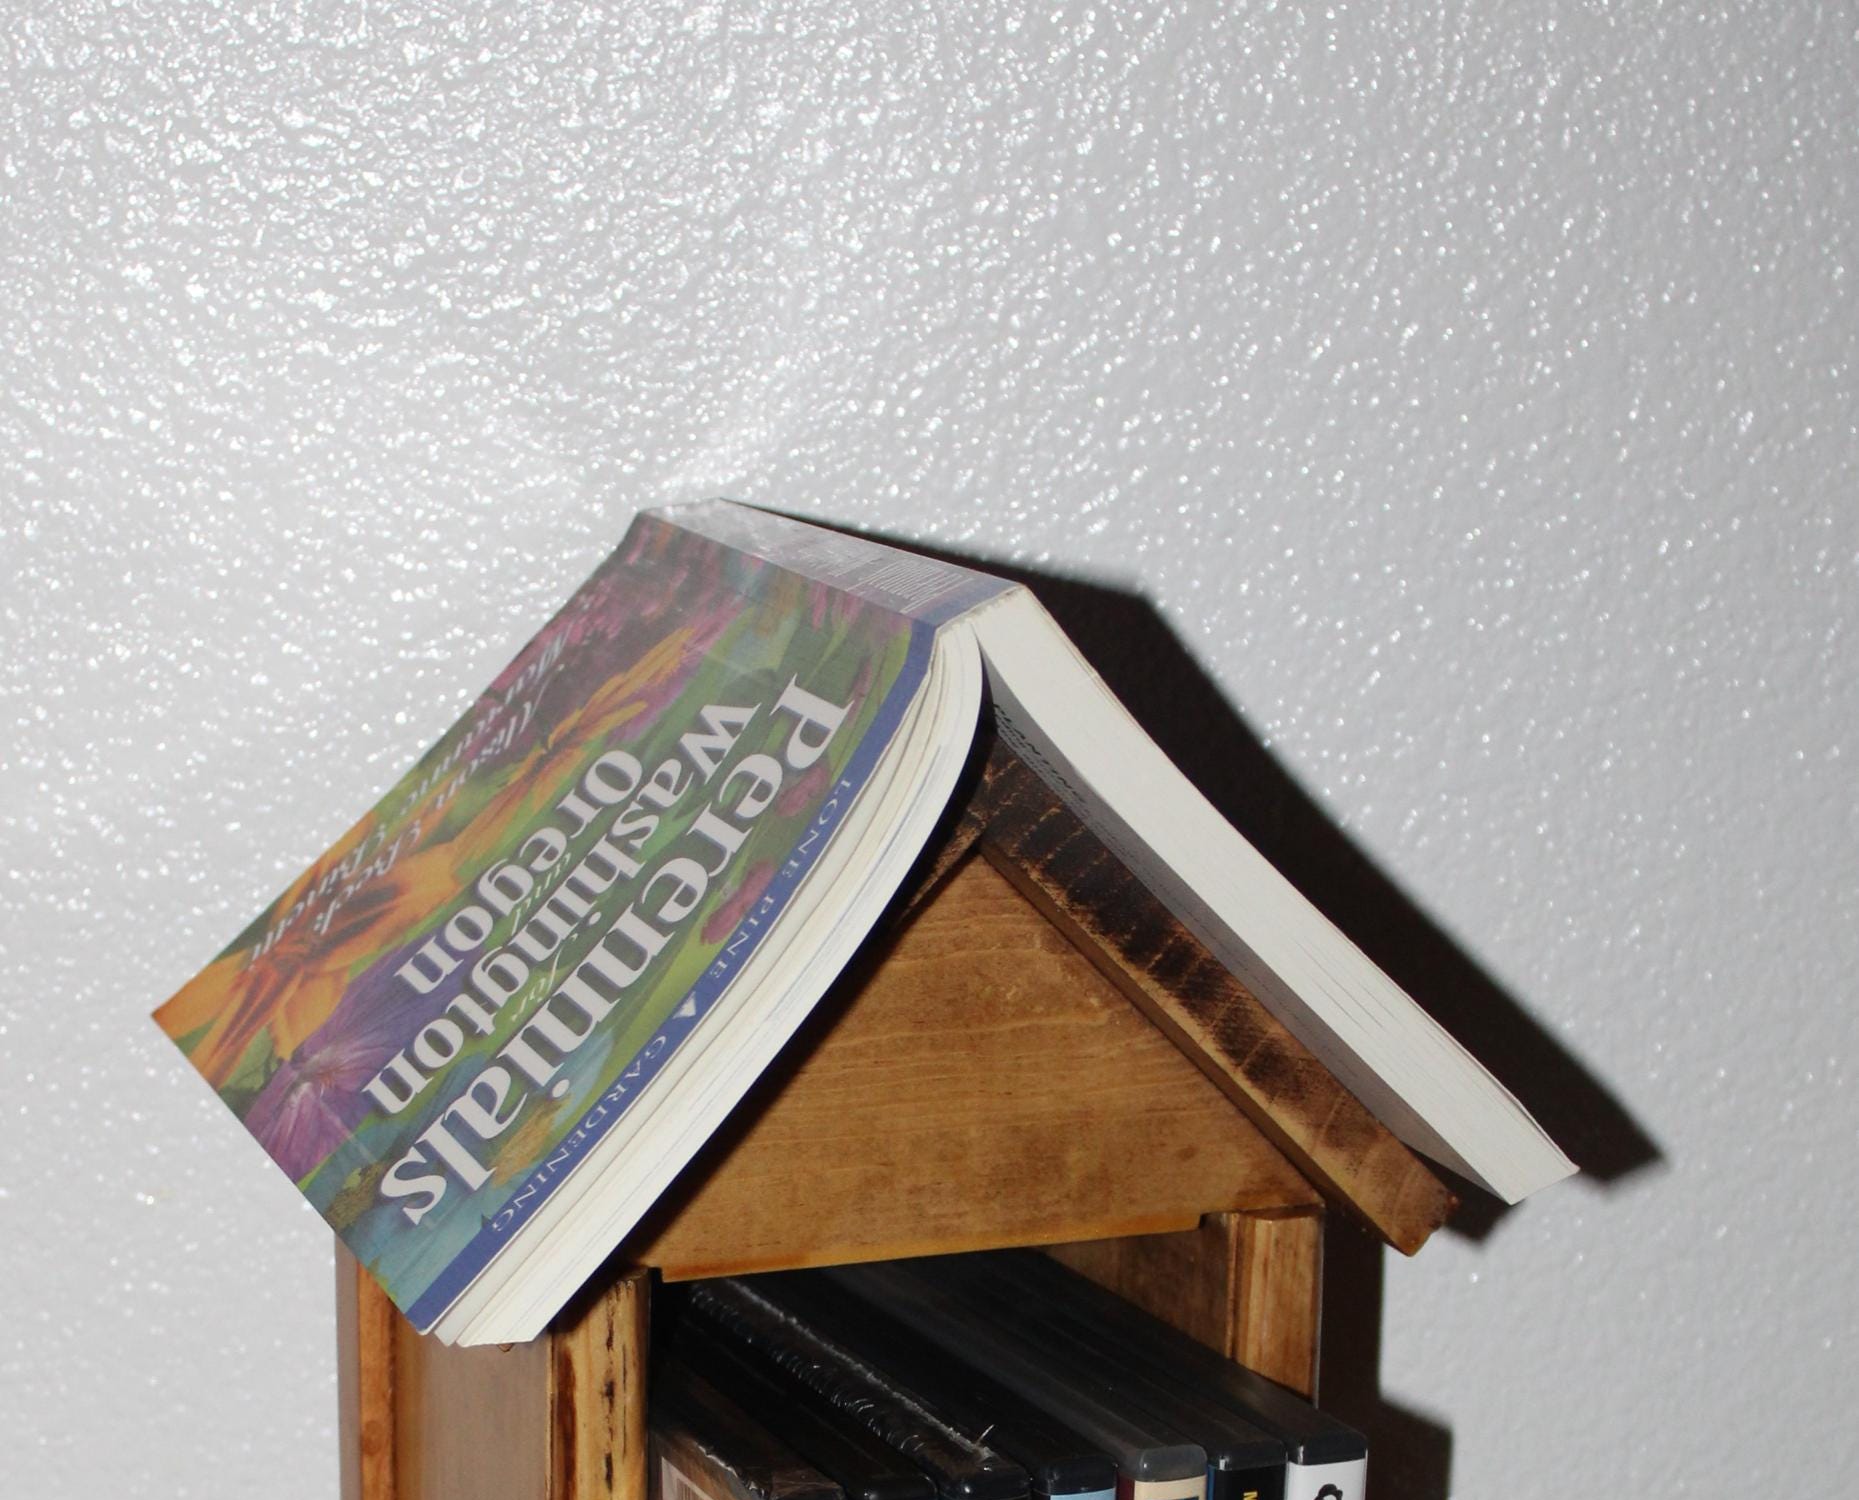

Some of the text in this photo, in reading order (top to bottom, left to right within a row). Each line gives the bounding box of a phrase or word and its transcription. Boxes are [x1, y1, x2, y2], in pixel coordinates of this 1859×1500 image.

[401, 605, 587, 817] Marianne
[434, 663, 565, 809] Alison
[362, 702, 761, 1116] Washington
[381, 673, 855, 1227] Perennials
[394, 749, 643, 995] Oregon
[511, 852, 572, 936] and
[511, 931, 579, 1022] for
[493, 778, 852, 1233] LONE PINE GARDENING
